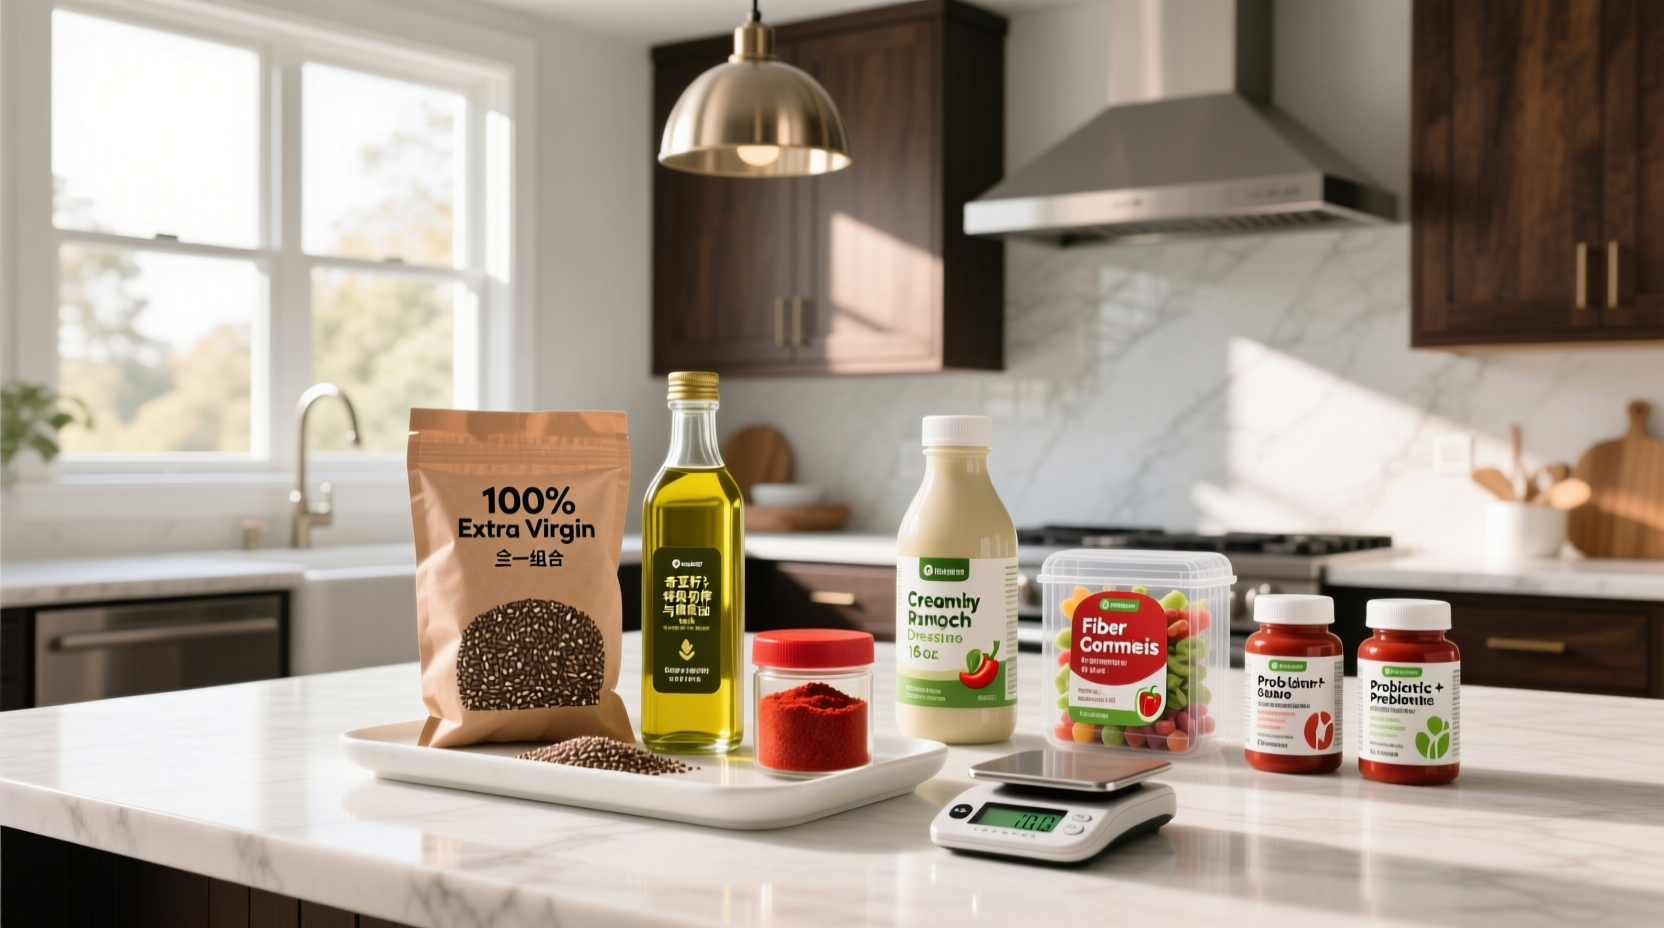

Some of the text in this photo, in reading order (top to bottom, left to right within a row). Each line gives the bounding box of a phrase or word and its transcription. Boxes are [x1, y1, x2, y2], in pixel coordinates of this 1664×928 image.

[482, 486, 576, 515] 100%
[458, 517, 596, 544] Extra Virgin
[1082, 617, 1128, 636] Fiber
